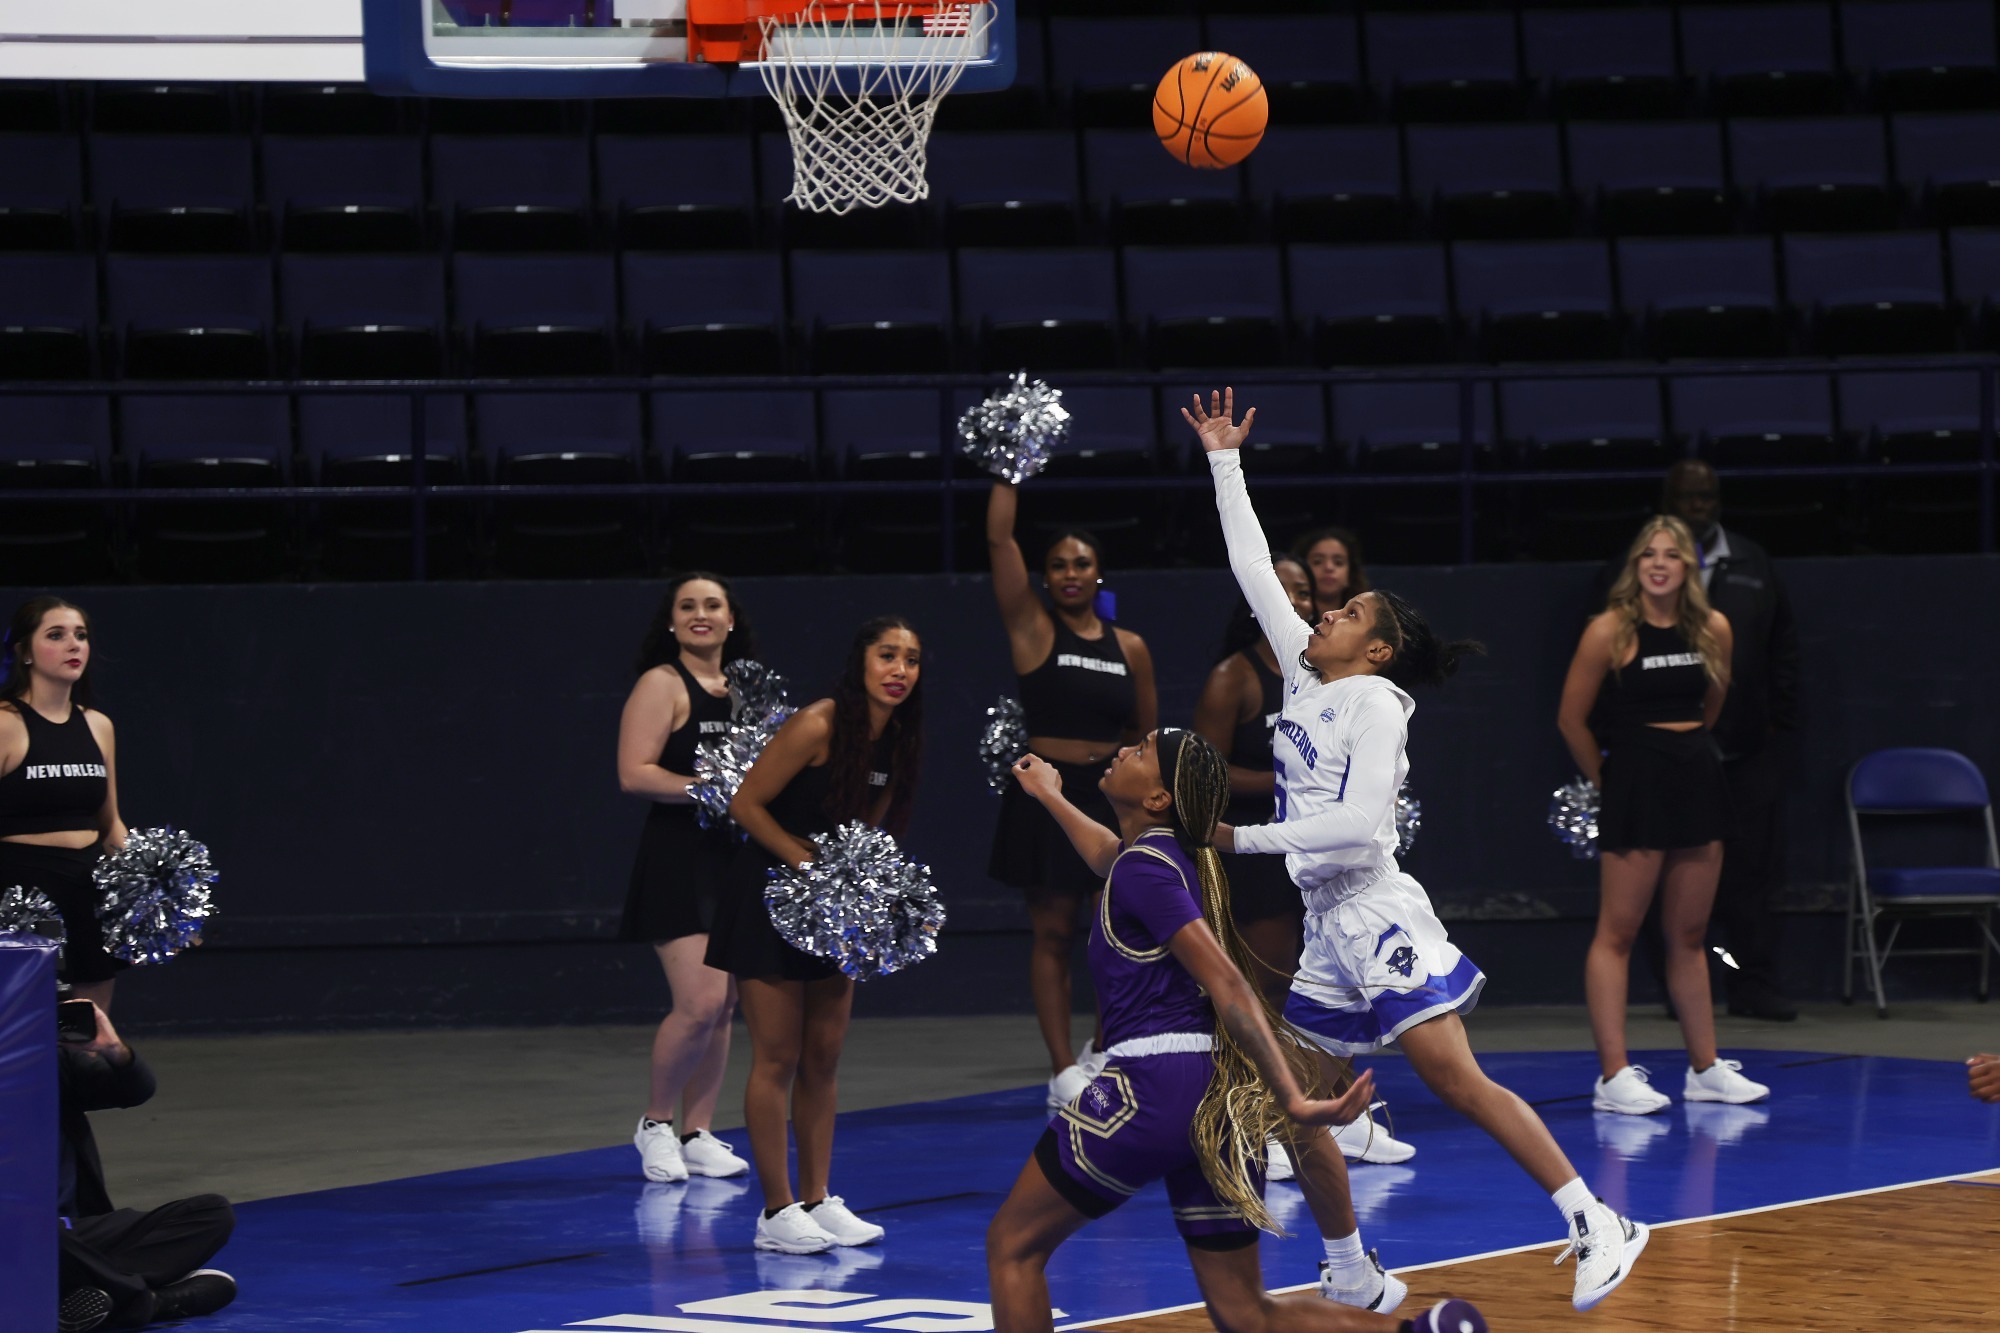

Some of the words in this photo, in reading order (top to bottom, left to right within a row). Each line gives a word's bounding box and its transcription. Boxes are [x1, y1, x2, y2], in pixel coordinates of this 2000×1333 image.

[699, 721, 725, 733] NEW
[26, 765, 61, 779] NEW
[62, 763, 107, 778] ORLEAN
